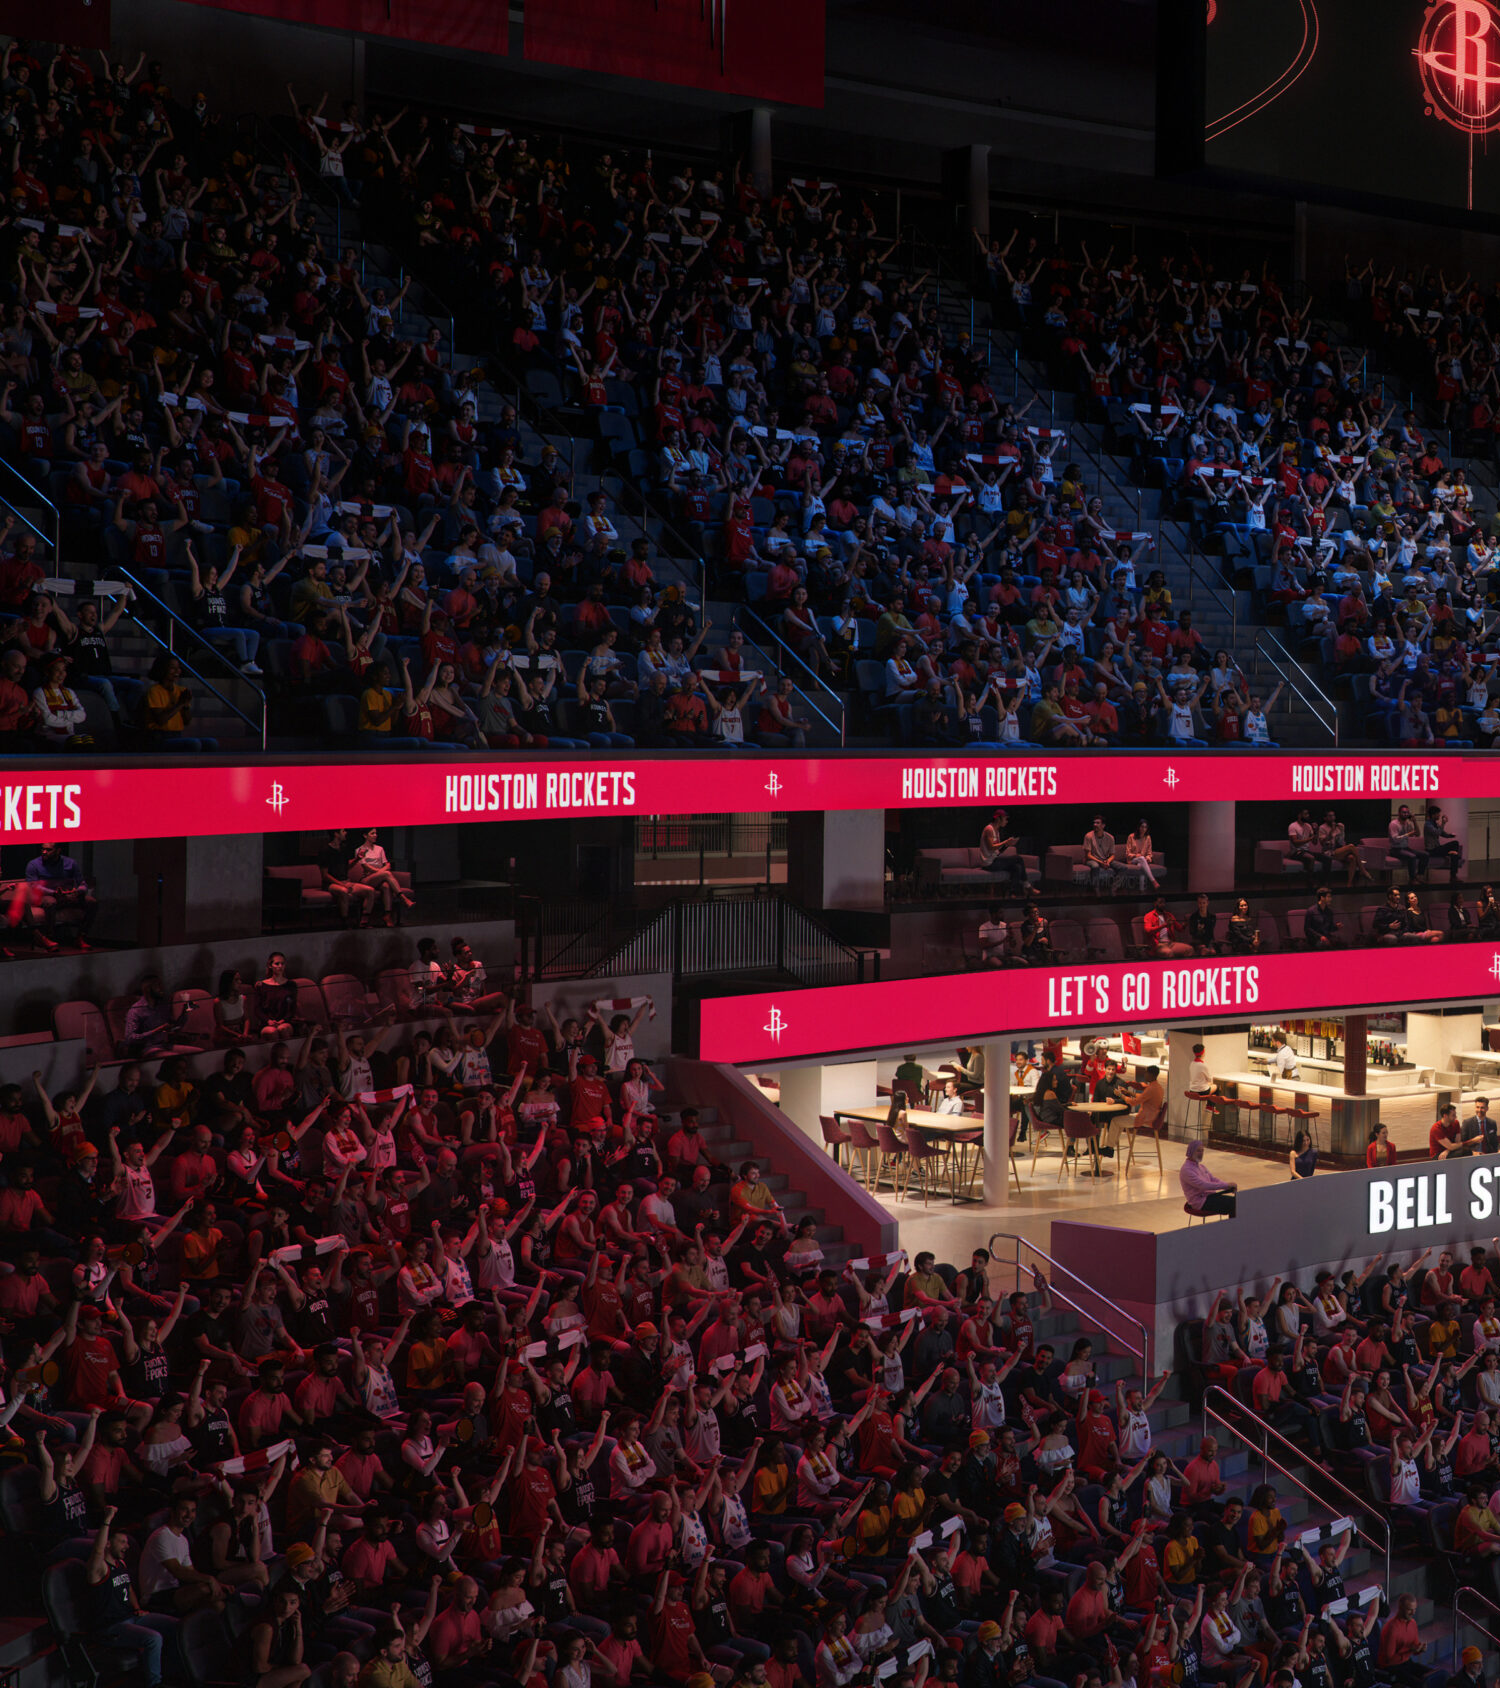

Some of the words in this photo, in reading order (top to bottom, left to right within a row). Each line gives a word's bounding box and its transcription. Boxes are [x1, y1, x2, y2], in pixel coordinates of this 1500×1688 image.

[446, 774, 537, 813] HOUSTON
[546, 772, 636, 808] ROCKETS
[903, 768, 978, 799] HOUSTON
[986, 767, 1056, 797] ROCKETS
[1293, 766, 1364, 793] HOUSTON
[1371, 765, 1438, 792] ROCKETS
[0, 785, 81, 831] KETS
[1048, 975, 1110, 1017] LET'S
[1122, 972, 1150, 1012] GO
[1162, 966, 1259, 1009] ROCKETS
[1369, 1173, 1453, 1234] BELL
